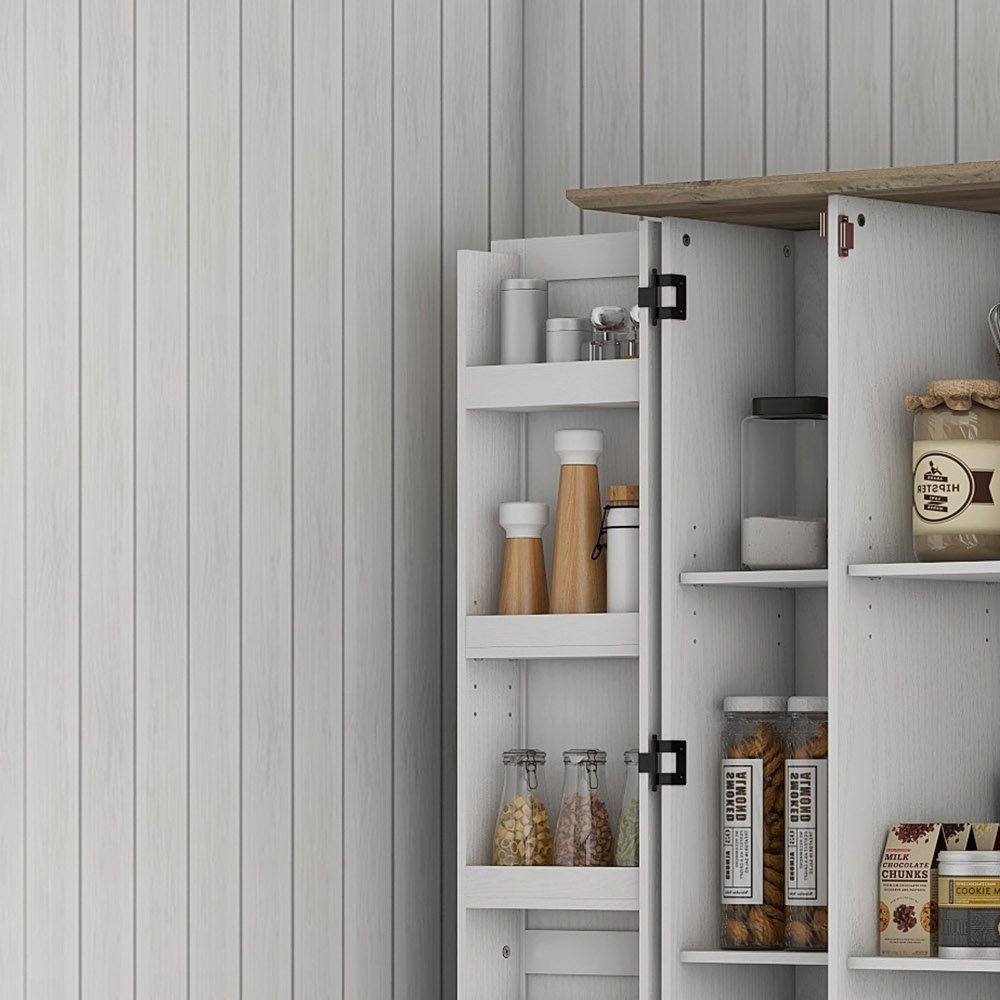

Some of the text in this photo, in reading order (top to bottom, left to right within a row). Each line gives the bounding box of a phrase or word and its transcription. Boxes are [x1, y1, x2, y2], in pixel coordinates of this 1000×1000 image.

[884, 853, 910, 861] MILK
[881, 869, 929, 879] CHUNKS
[955, 887, 991, 895] COOKIE
